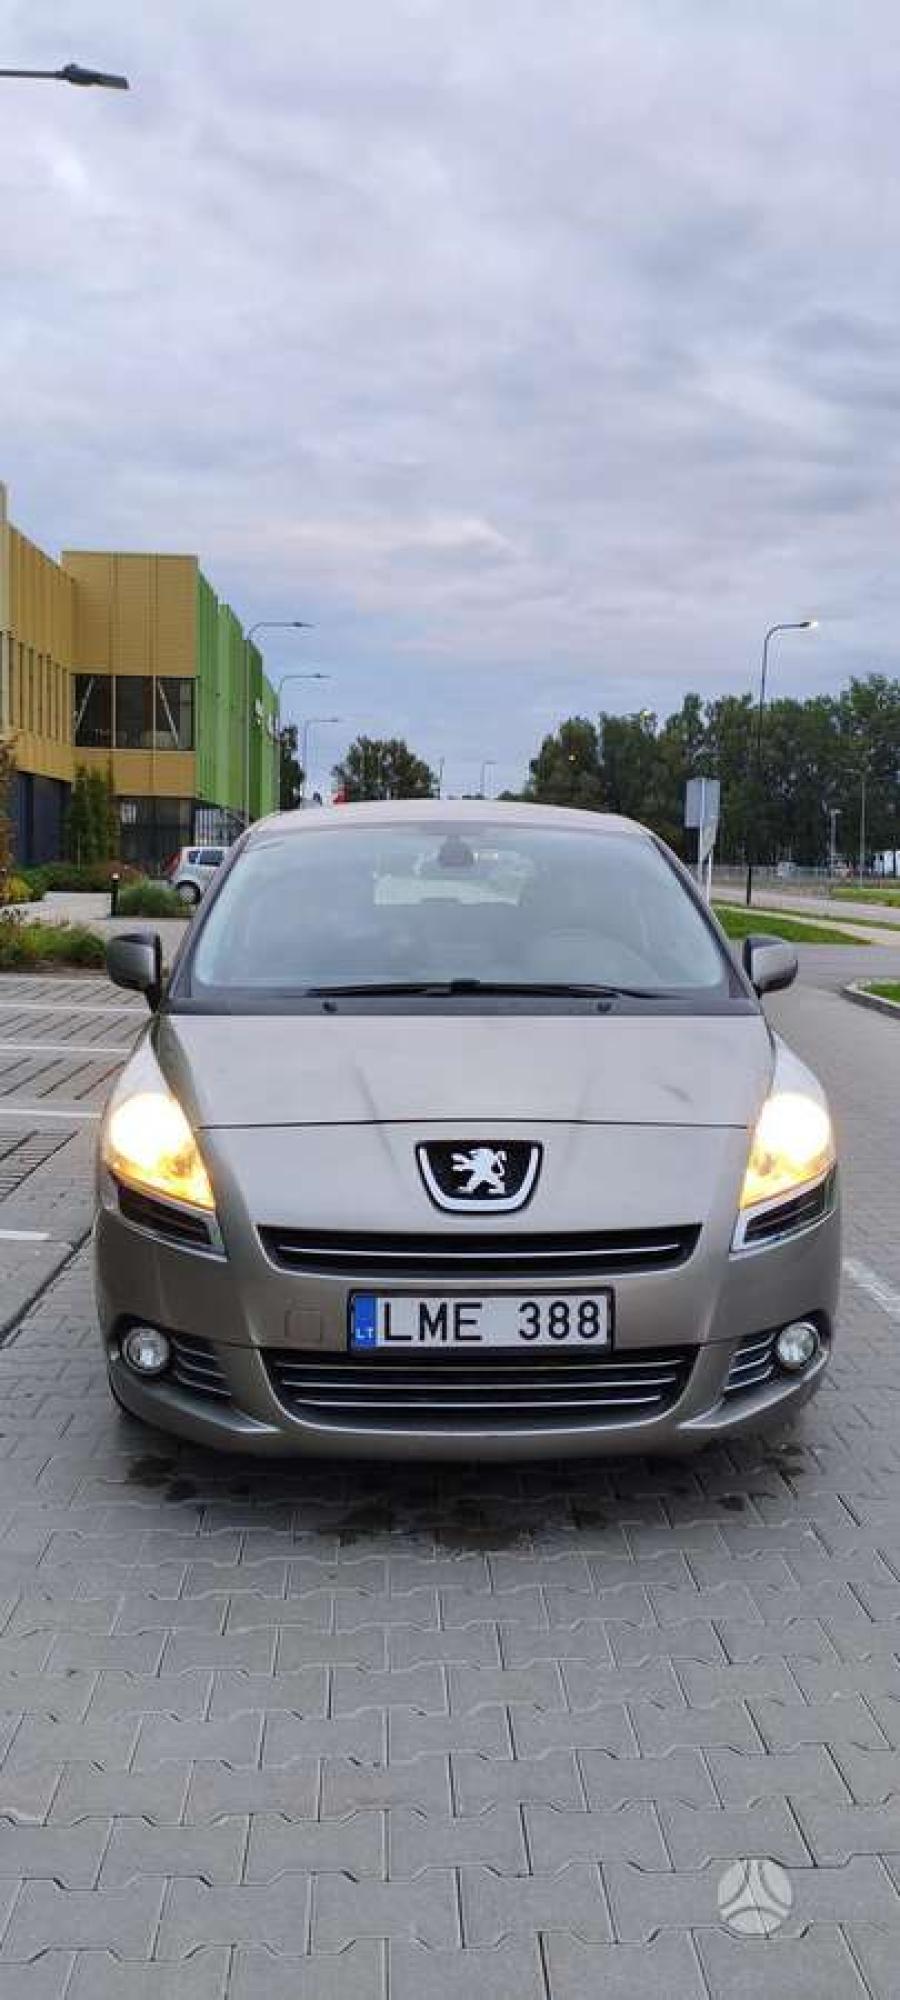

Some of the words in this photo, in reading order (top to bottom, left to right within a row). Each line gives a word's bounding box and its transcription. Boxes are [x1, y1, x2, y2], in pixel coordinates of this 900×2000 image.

[355, 1327, 374, 1340] LT
[383, 1301, 483, 1342] LME
[518, 1300, 600, 1341] 388
